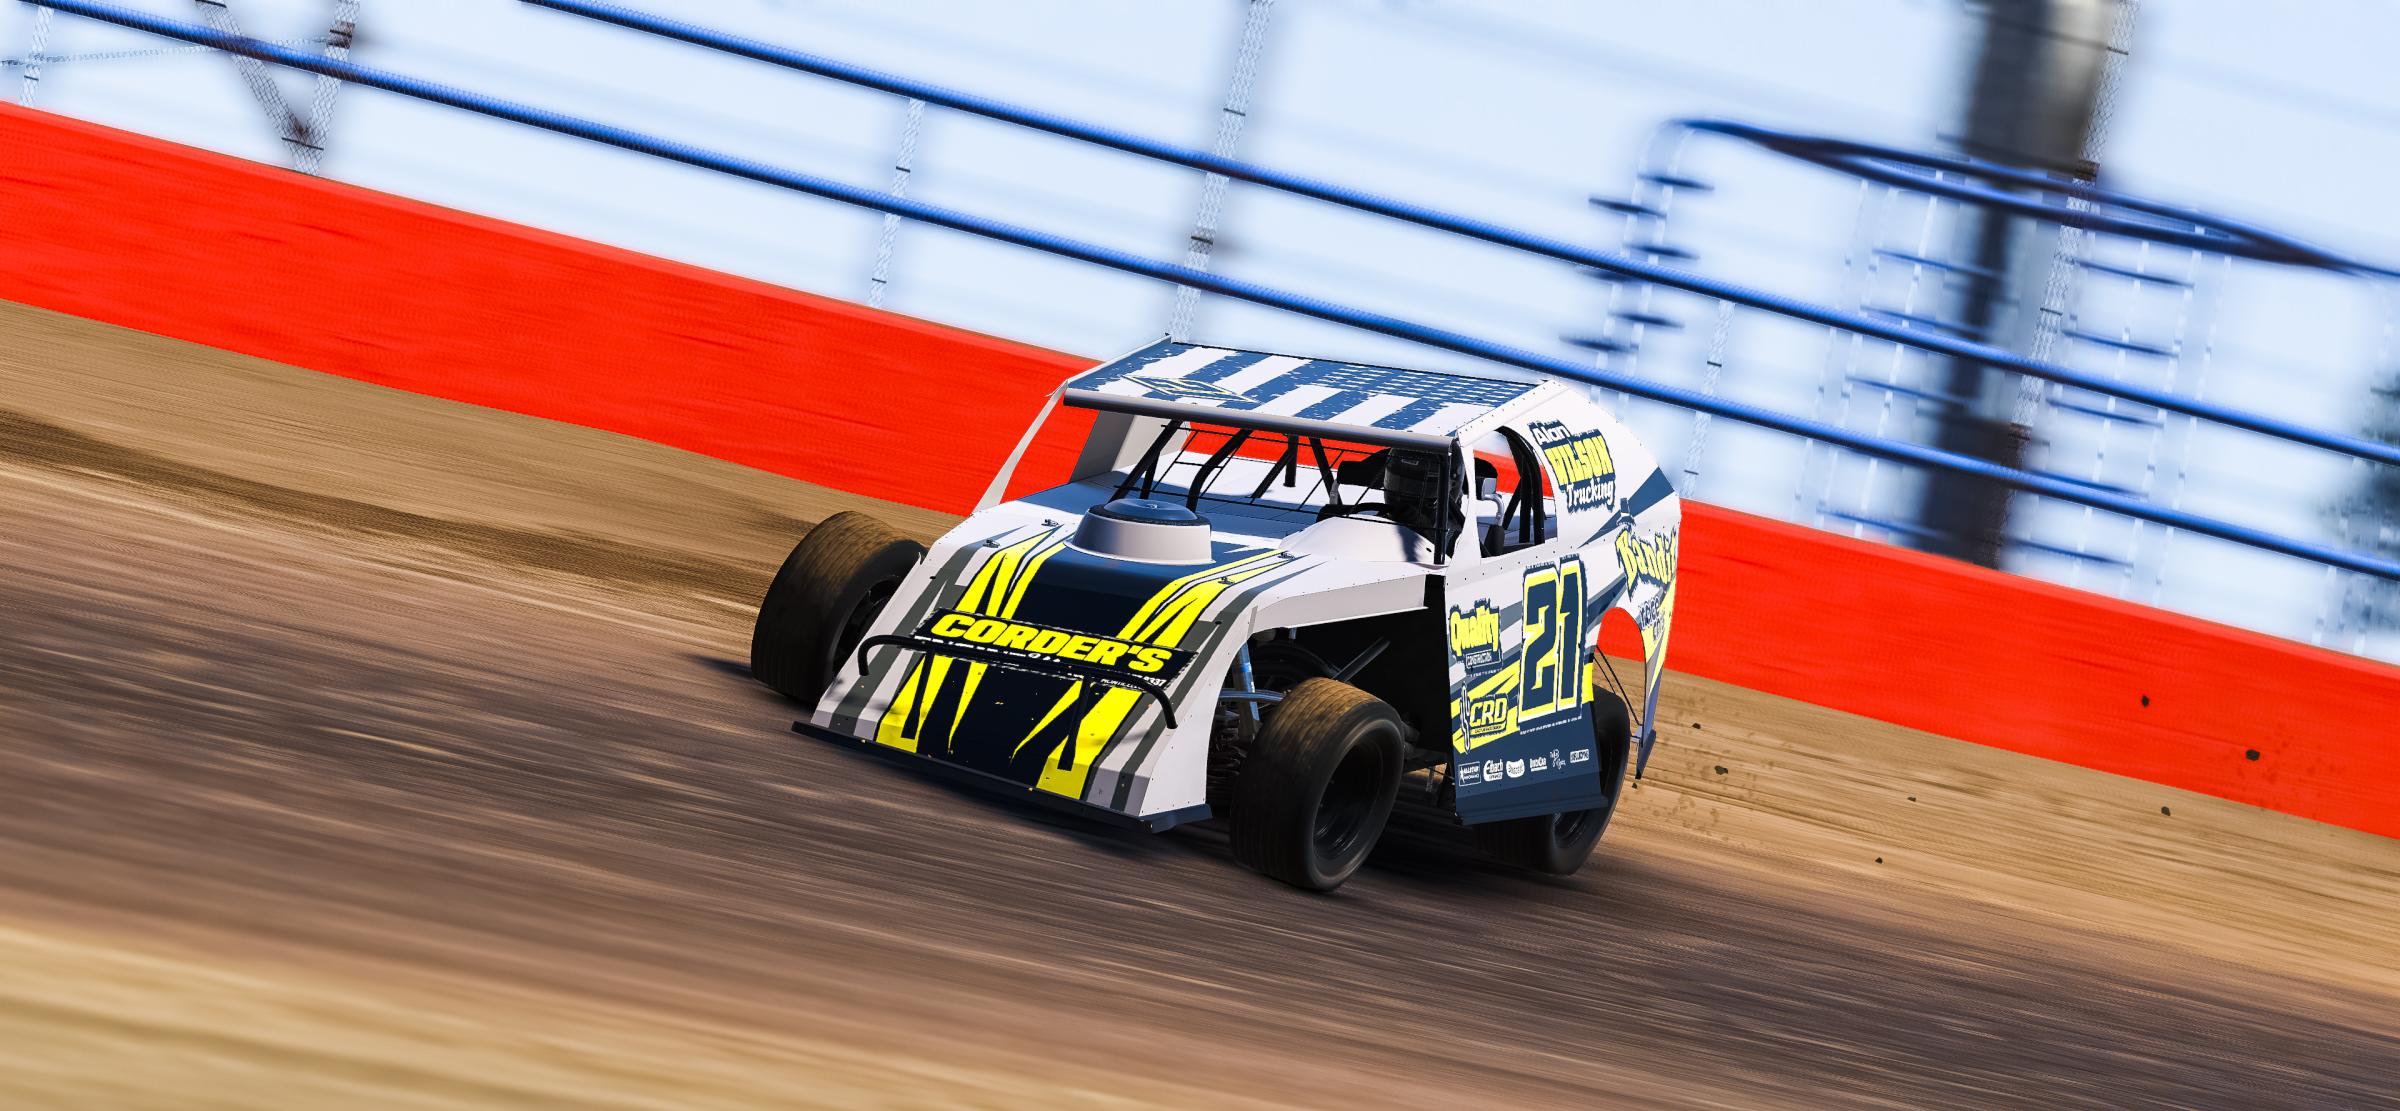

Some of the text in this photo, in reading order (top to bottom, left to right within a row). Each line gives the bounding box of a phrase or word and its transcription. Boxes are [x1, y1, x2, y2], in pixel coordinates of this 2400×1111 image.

[1533, 424, 1571, 447] Alan
[1543, 434, 1616, 486] WILSON
[1565, 477, 1616, 510] Trucking
[1614, 529, 1677, 592] Bandit
[930, 613, 1173, 674] CORDER'S
[1450, 604, 1500, 657] Quality
[1517, 559, 1583, 724] 21
[1469, 697, 1509, 728] CRD
